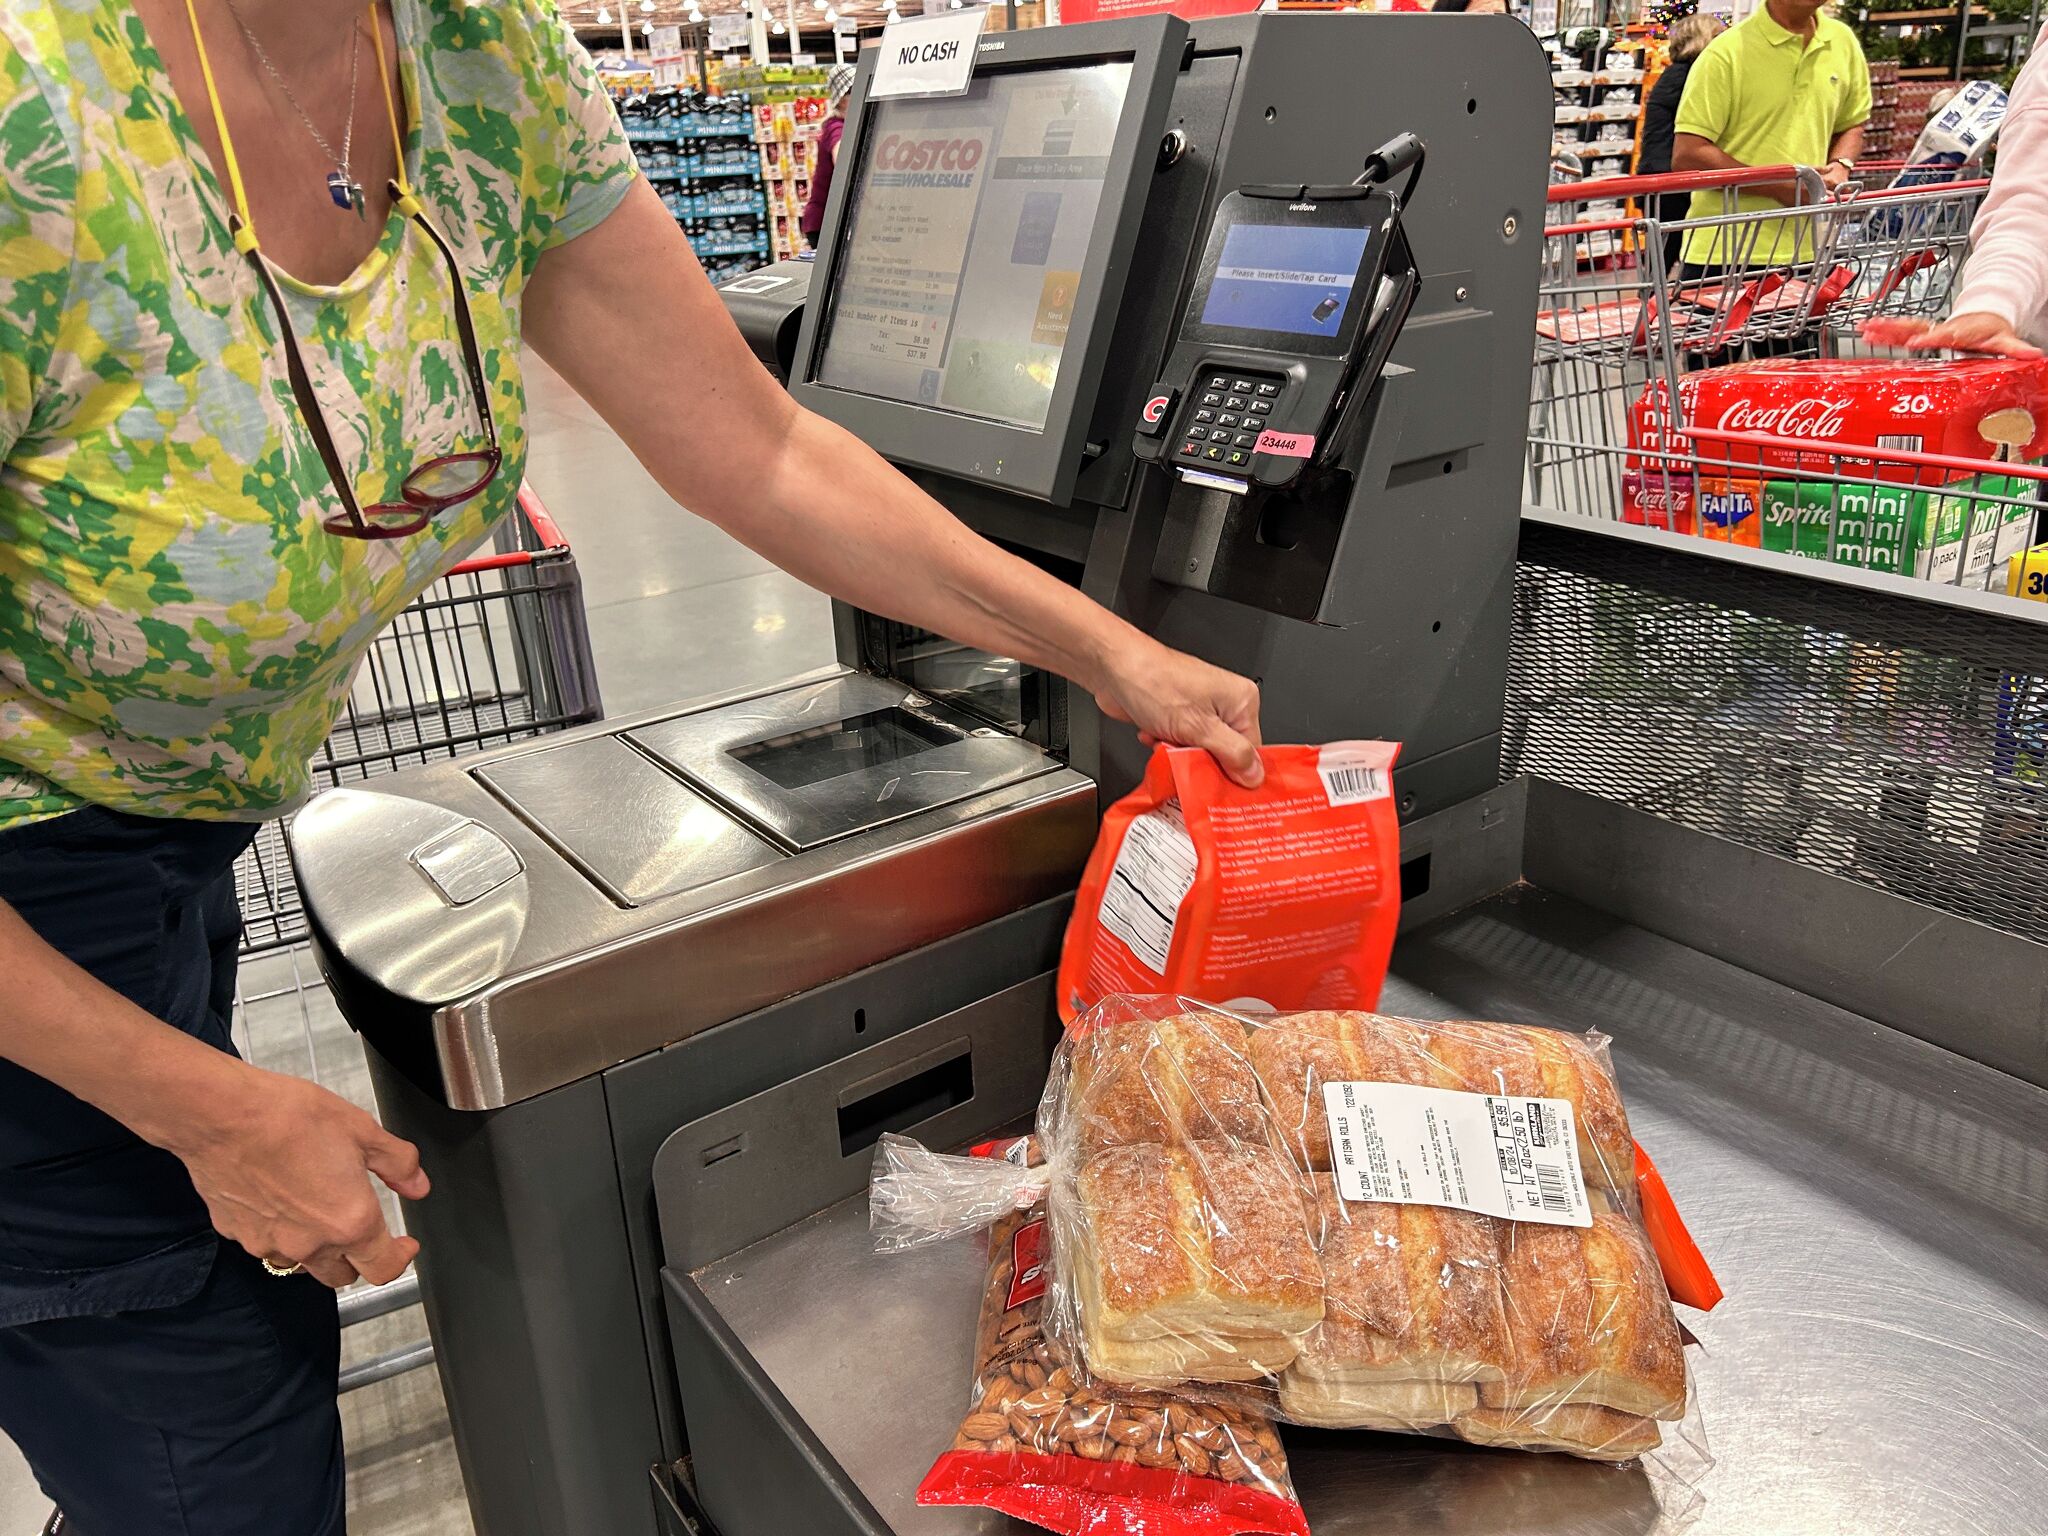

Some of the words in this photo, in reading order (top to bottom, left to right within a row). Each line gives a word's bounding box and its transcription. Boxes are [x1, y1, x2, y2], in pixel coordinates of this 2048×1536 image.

[899, 46, 918, 65] NO
[922, 41, 959, 62] CASH
[979, 42, 1005, 52] TOSHIBA
[876, 134, 982, 171] COSTCO
[903, 173, 974, 188] WHOLESALE
[1289, 203, 1317, 212] Verifone
[1232, 269, 1254, 278] Please
[1318, 275, 1337, 283] Card
[838, 309, 854, 319] Total
[880, 314, 886, 323] of
[1236, 381, 1242, 389] 2
[1259, 384, 1265, 393] 3
[1204, 394, 1208, 403] 4
[1227, 398, 1232, 406] 5
[1251, 401, 1257, 410] 6
[1889, 395, 1929, 413] 30
[1220, 414, 1225, 423] 8
[1243, 418, 1249, 427] 9
[1716, 398, 1855, 438] Coca-Cola
[1212, 432, 1218, 440] 0
[1840, 493, 1907, 516] mini
[1837, 516, 1903, 541] mini
[1835, 540, 1899, 565] mini
[1940, 548, 1958, 564] pack
[1343, 1084, 1355, 1108] 1221092
[1495, 1105, 1509, 1127] $5.99
[1337, 1116, 1349, 1135] ROLLS
[1529, 1104, 1540, 1145] KIRKLAND
[1342, 1138, 1355, 1165] ARTISAN
[1522, 1159, 1533, 1169] 40
[1358, 1170, 1370, 1189] COUNT
[1524, 1174, 1536, 1185] WT
[1363, 1192, 1373, 1200] 12
[1527, 1191, 1540, 1207] NET
